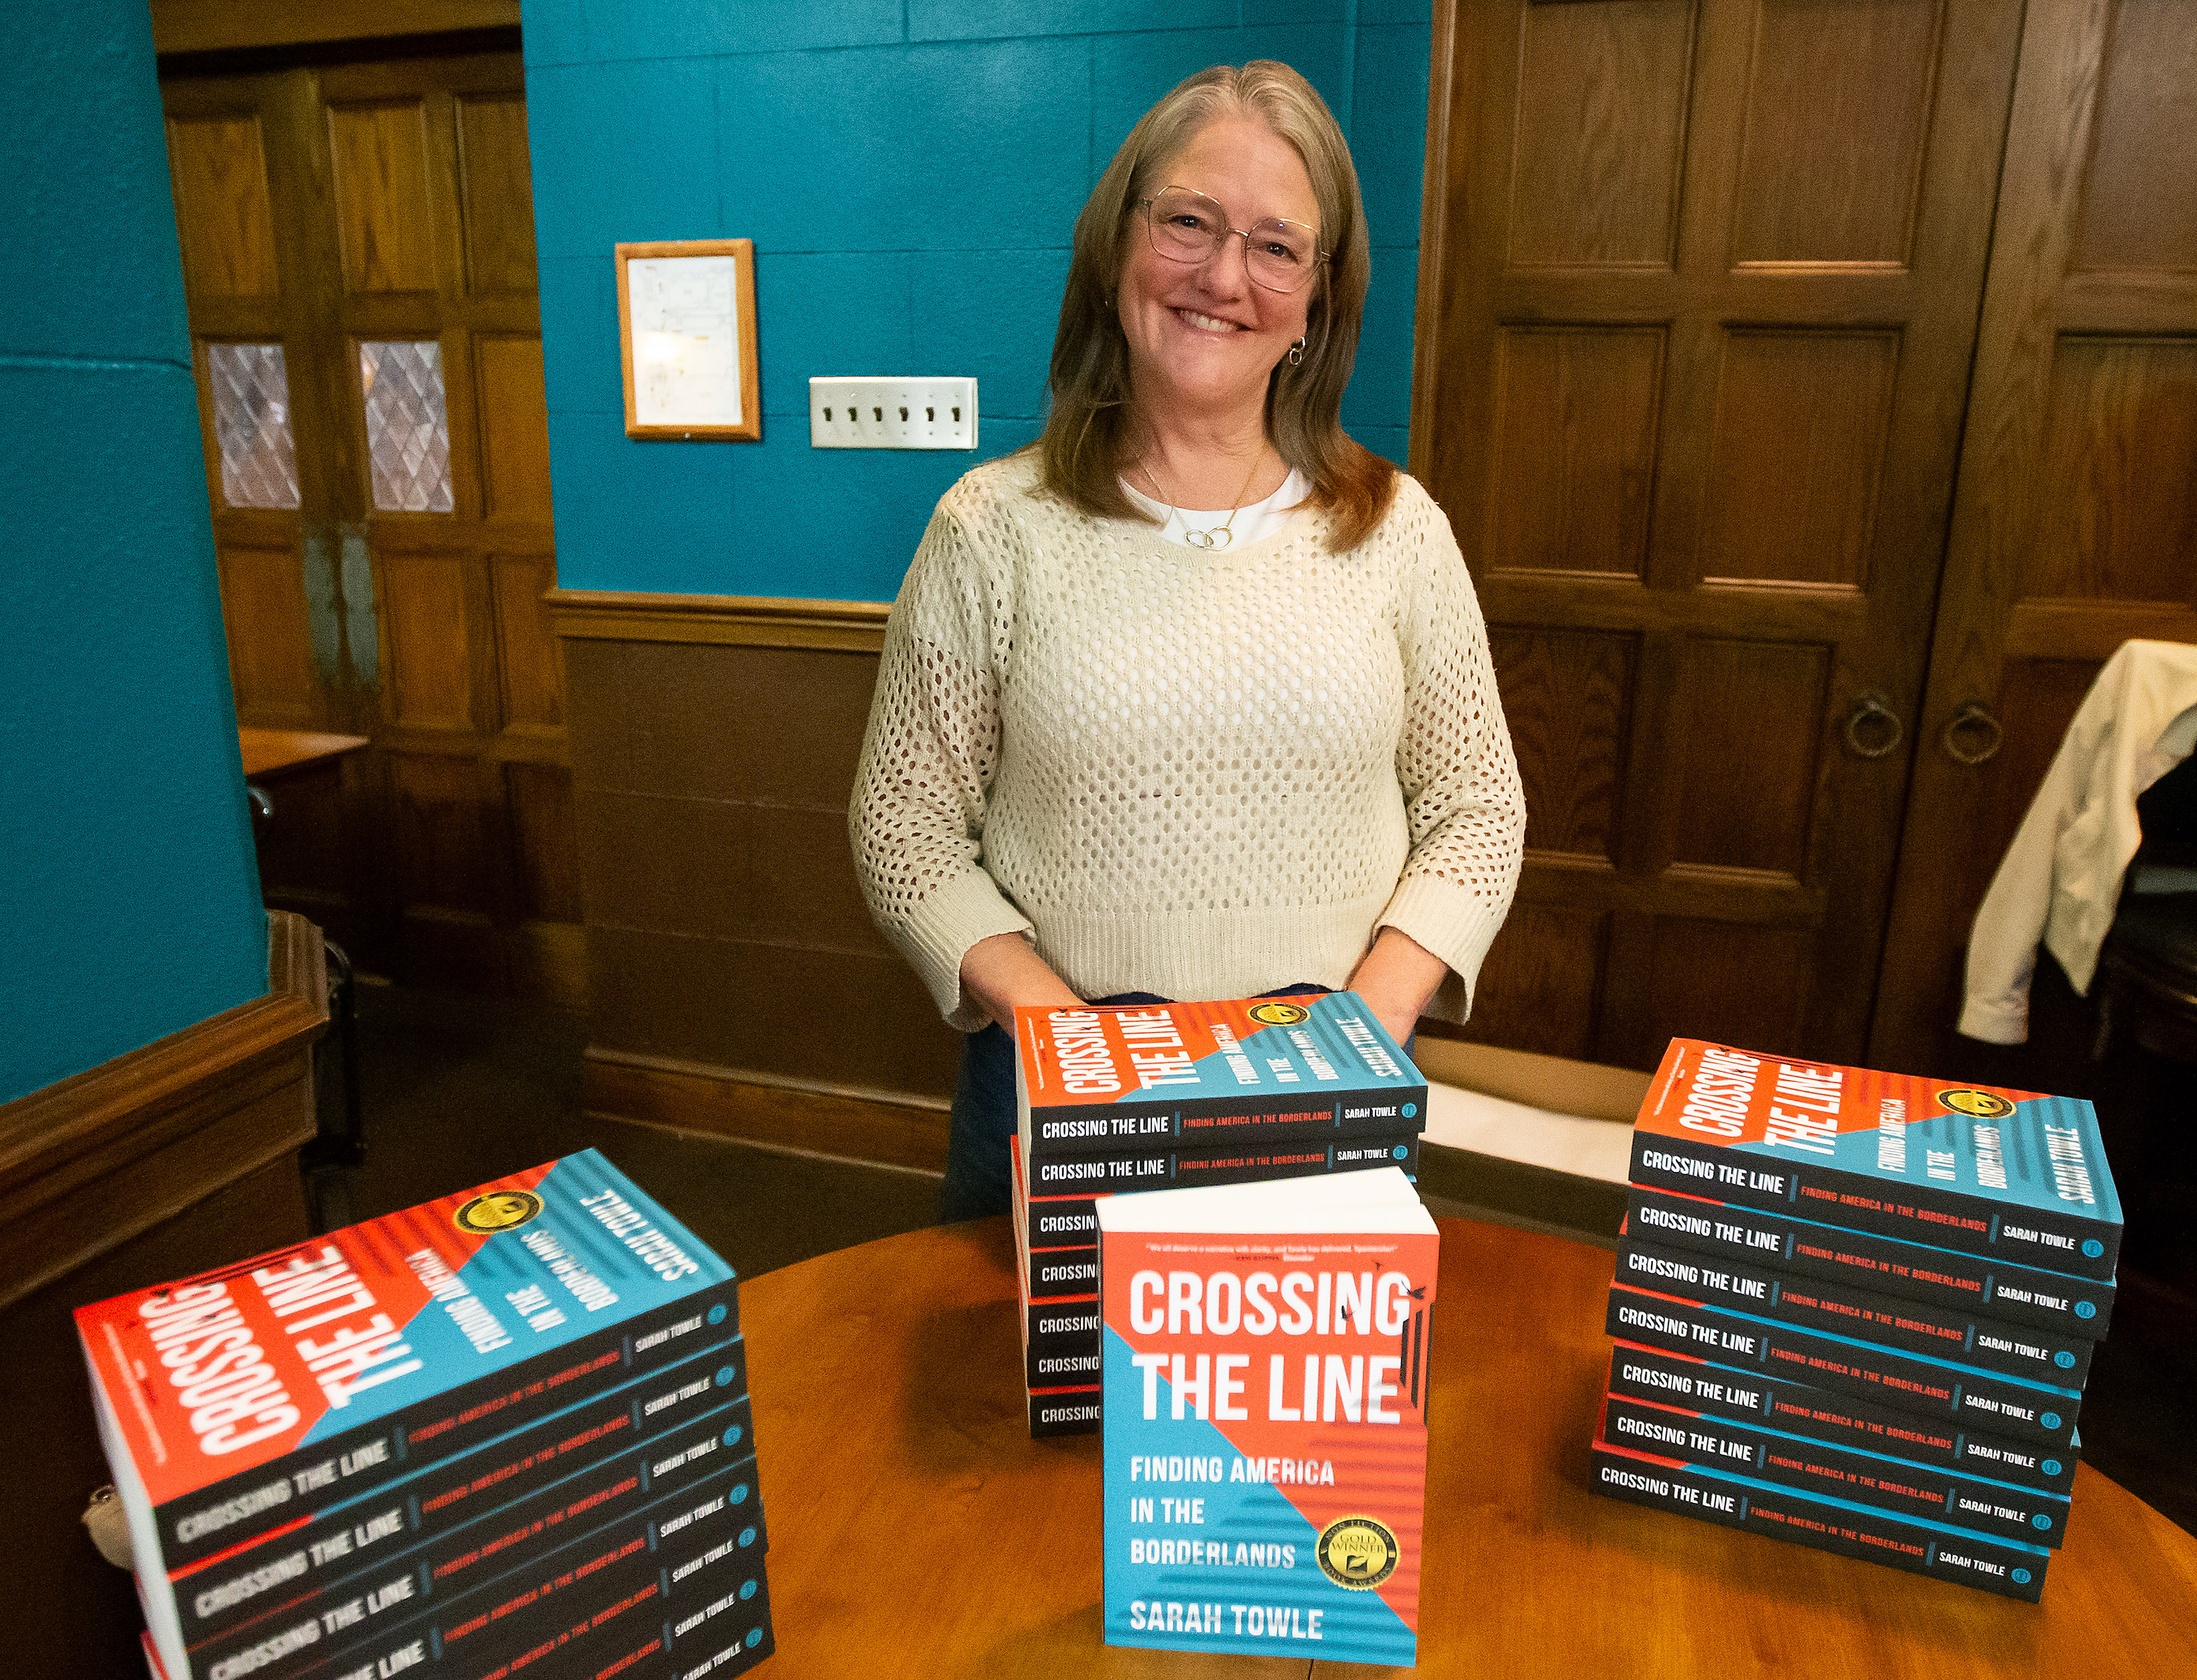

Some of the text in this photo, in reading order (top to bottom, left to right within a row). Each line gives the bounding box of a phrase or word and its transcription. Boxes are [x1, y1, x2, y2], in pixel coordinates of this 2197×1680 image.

[1048, 1012, 1121, 1094] CROSSING
[1116, 1010, 1201, 1090] THE LINE
[1266, 1057, 1294, 1072] THE
[1340, 1017, 1403, 1077] SARAH TOWLE
[1275, 1072, 1300, 1082] IN
[1680, 1049, 1760, 1137] CROSSING
[1043, 1117, 1168, 1138] CROSSING THE LINE
[1184, 1118, 1214, 1127] FINDING
[1216, 1116, 1249, 1126] AMERICA
[1263, 1114, 1276, 1123] THE
[1279, 1112, 1332, 1122] BORDERLANDS
[1345, 1107, 1397, 1119] SARAH TOWLE
[1761, 1064, 1843, 1155] THE LINE
[1042, 1159, 1164, 1180] CROSSING THE LINE
[1180, 1160, 1209, 1169] FINDING
[1211, 1159, 1244, 1167] AMERICA
[1273, 1154, 1324, 1164] BORDERLANDS
[1337, 1149, 1388, 1160] SARAH TOWLE
[1643, 1150, 1784, 1194] CROSSING THE LINE
[1927, 1149, 1956, 1181] IN THE
[2045, 1124, 2095, 1204] SARAH TOWLE
[580, 1189, 649, 1238] TOWLE
[1640, 1207, 1780, 1251] CROSSING THE LINE
[1802, 1186, 1986, 1231] FINDING AMERICA IN THE BORDERLANDS
[624, 1229, 699, 1281] SARAH
[2003, 1226, 2075, 1249] SARAH TOWLE
[1629, 1253, 1766, 1299] CROSSING THE LINE
[1797, 1244, 1981, 1291] FINDING AMERICA IN THE BORDERLANDS
[505, 1284, 567, 1333] IN THE
[1130, 1270, 1411, 1336] CROSSING
[1783, 1292, 1962, 1340] FINDING AMERICA IN THE BORDERLANDS
[1998, 1286, 2068, 1310] SARAH TOWLE
[252, 1247, 423, 1409] THE LINE
[636, 1315, 702, 1352] SARAH TOWLE
[1619, 1307, 1755, 1354] CROSSING THE LINE
[1979, 1336, 2048, 1360] SARAH TOWLE
[139, 1283, 300, 1455] CROSSING
[1039, 1356, 1098, 1373] CROSSING
[1771, 1348, 1949, 1399] FINDING AMERICA IN THE BORDERLANDS
[645, 1377, 710, 1416] SARAH TOWLE
[1132, 1354, 1401, 1424] THE LINE
[1623, 1365, 1759, 1408] CROSSING THE LINE
[1775, 1403, 1952, 1449] FINDING AMERICA IN THE BORDERLANDS
[1966, 1395, 2034, 1421] SARAH TOWLE
[653, 1437, 717, 1477] SARAH TOWLE
[1618, 1417, 1752, 1461] CROSSING THE LINE
[1968, 1444, 2035, 1468] SARAH TOWLE
[1131, 1455, 1334, 1486] FINDING AMERICA
[1602, 1468, 1734, 1512] CROSSING THE LINE
[1769, 1455, 1943, 1502] FINDING AMERICA IN THE BORDERLANDS
[661, 1496, 725, 1537] SARAH TOWLE
[1131, 1497, 1204, 1524] IN THE
[1751, 1507, 1785, 1522] FINDING
[1788, 1516, 1825, 1532] AMERICA
[1841, 1529, 1856, 1539] THE
[1860, 1534, 1924, 1556] BORDERLANDS
[1960, 1499, 2026, 1522] SARAH TOWLE
[1131, 1538, 1295, 1569] BORDERLANDS
[1332, 1542, 1386, 1554] WINNER
[1340, 1535, 1377, 1543] GOLD
[673, 1540, 733, 1582] SARAH TOWLE
[1939, 1552, 2005, 1576] SARAH TOWLE
[675, 1593, 734, 1636] SARAH TOWLE
[1130, 1601, 1323, 1639] SARAH TOWLE
